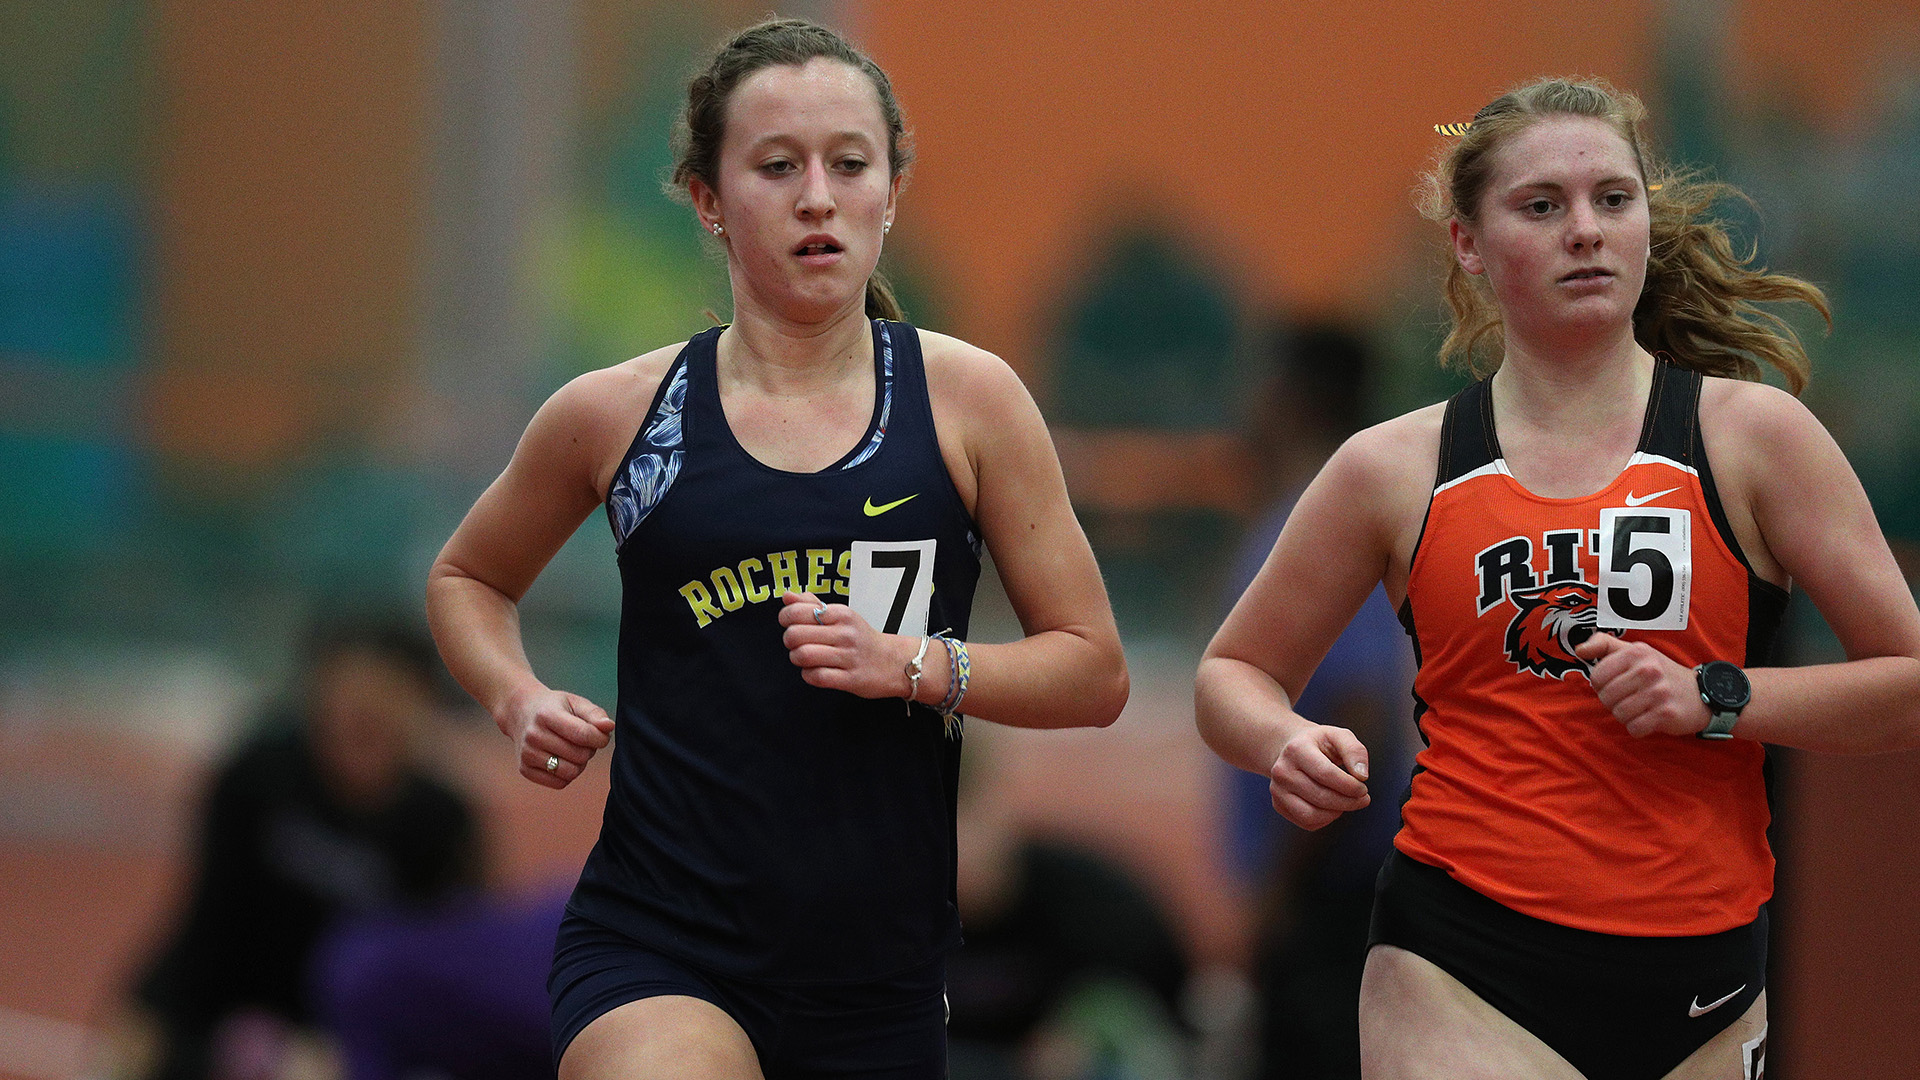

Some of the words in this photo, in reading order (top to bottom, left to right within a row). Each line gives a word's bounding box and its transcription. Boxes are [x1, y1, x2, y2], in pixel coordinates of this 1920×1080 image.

[678, 549, 935, 629] ROCHES
[871, 550, 921, 636] 7
[1475, 529, 1600, 618] RI
[1607, 516, 1674, 621] 5
